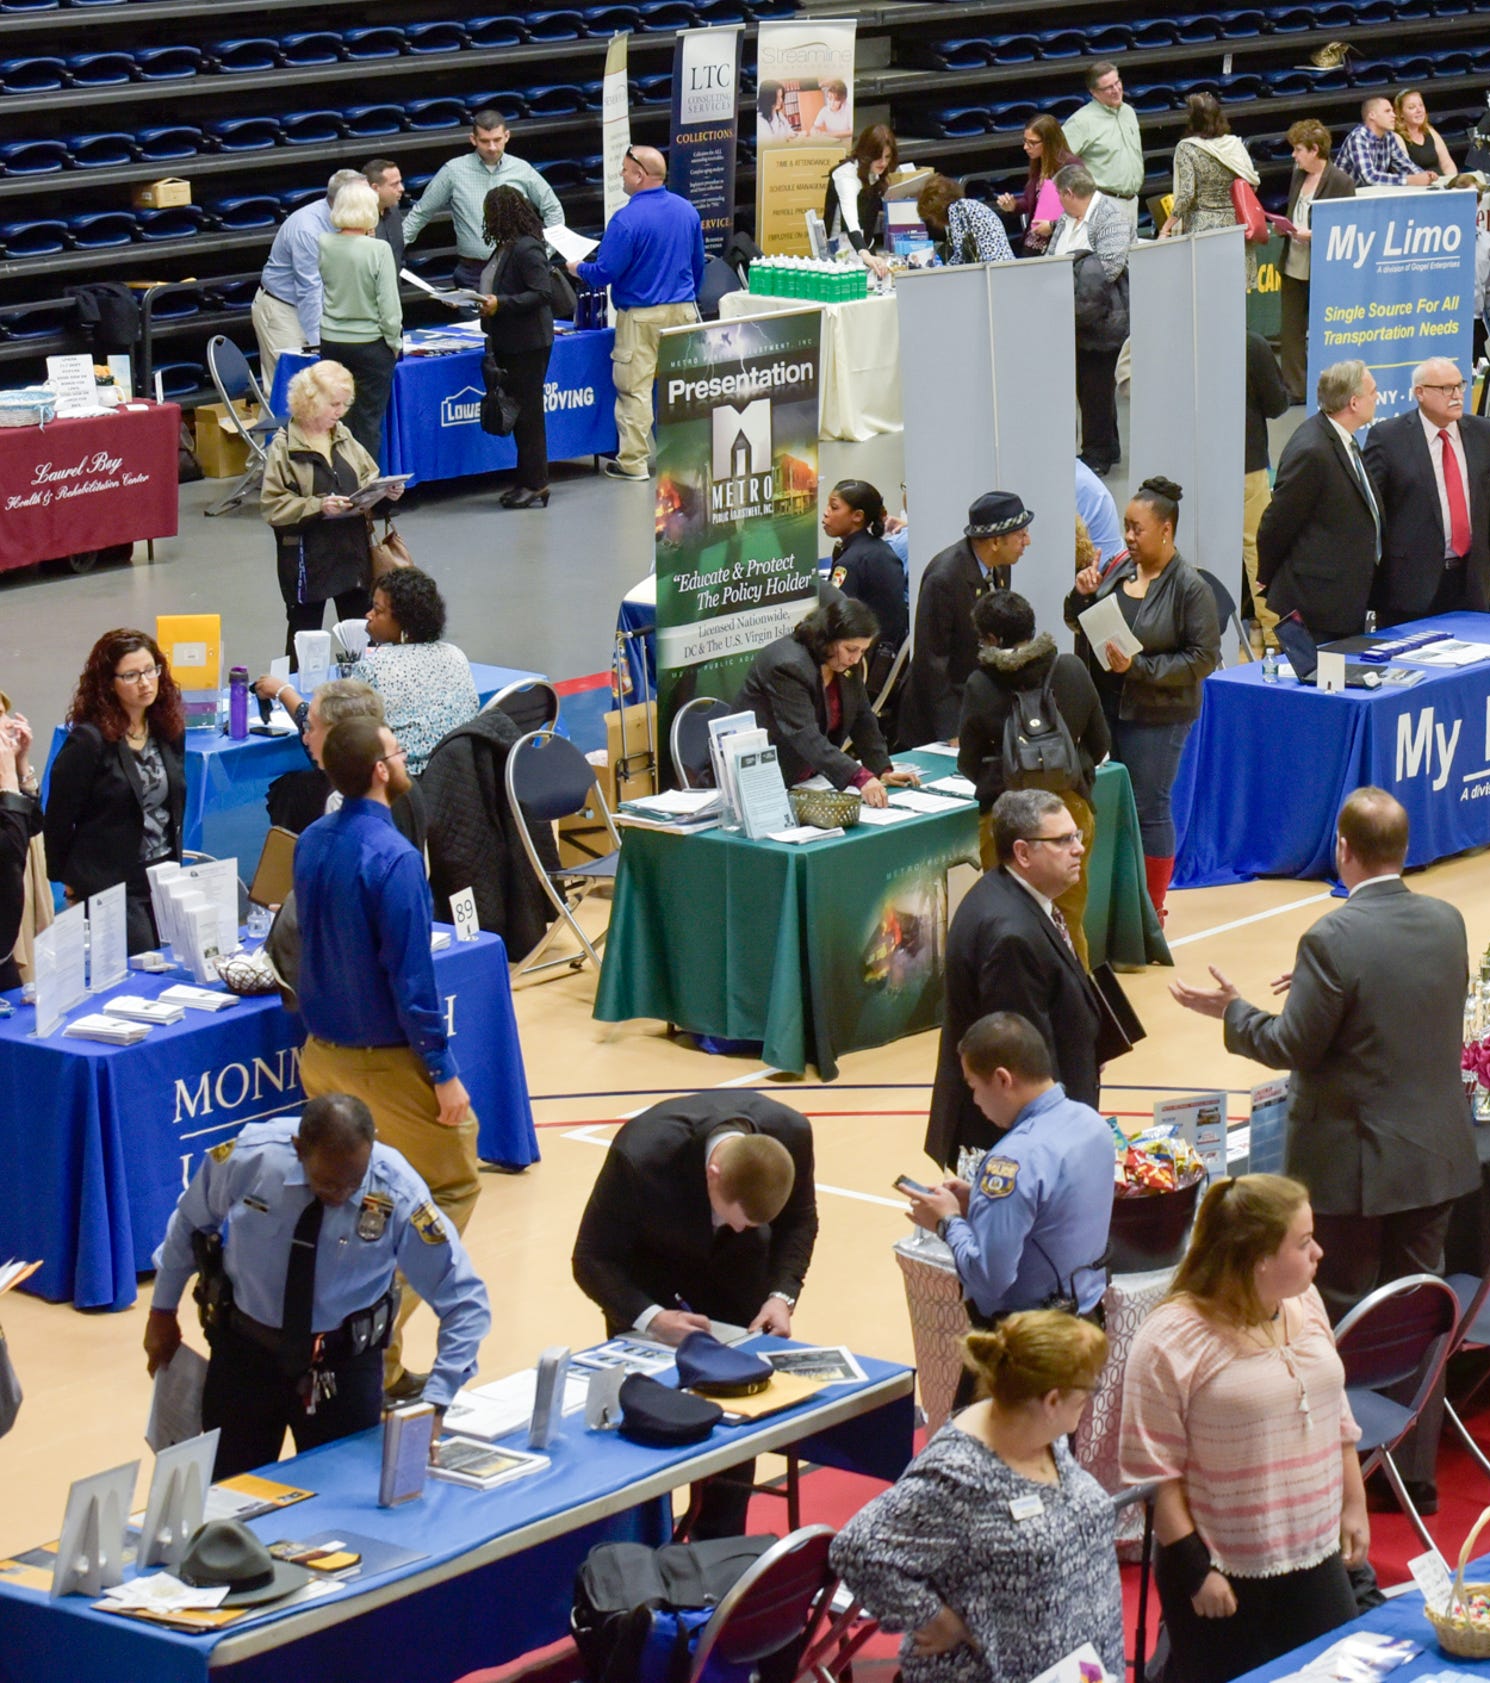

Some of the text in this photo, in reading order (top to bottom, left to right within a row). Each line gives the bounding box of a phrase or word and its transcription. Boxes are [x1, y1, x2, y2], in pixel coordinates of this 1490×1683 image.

[761, 46, 852, 64] Streamline
[689, 63, 730, 91] LTC
[687, 101, 730, 114] SERVICES
[701, 217, 733, 230] ERVICE
[1326, 219, 1461, 269] My Limo
[1383, 263, 1404, 274] division
[1324, 295, 1460, 324] Single Source For All
[1323, 320, 1460, 346] Transportation Needs
[668, 361, 814, 404] Presentation
[448, 402, 481, 421] LOWE
[31, 451, 123, 485] Laurel Bay
[5, 472, 150, 511] Health & Rehabilitation Center
[712, 475, 772, 510] METRO
[712, 511, 728, 525] PUBLIC
[732, 562, 744, 581] &
[746, 553, 795, 578] Protect
[697, 590, 720, 611] The
[721, 581, 763, 606] Policy
[698, 608, 791, 638] Licensed Nationwide,
[684, 645, 697, 658] DC
[698, 642, 706, 655] &
[706, 637, 723, 652] The
[725, 632, 744, 648] U.S.
[744, 628, 773, 645] Virgin
[1396, 706, 1462, 791] My
[1460, 787, 1469, 801] A
[456, 899, 473, 923] 89
